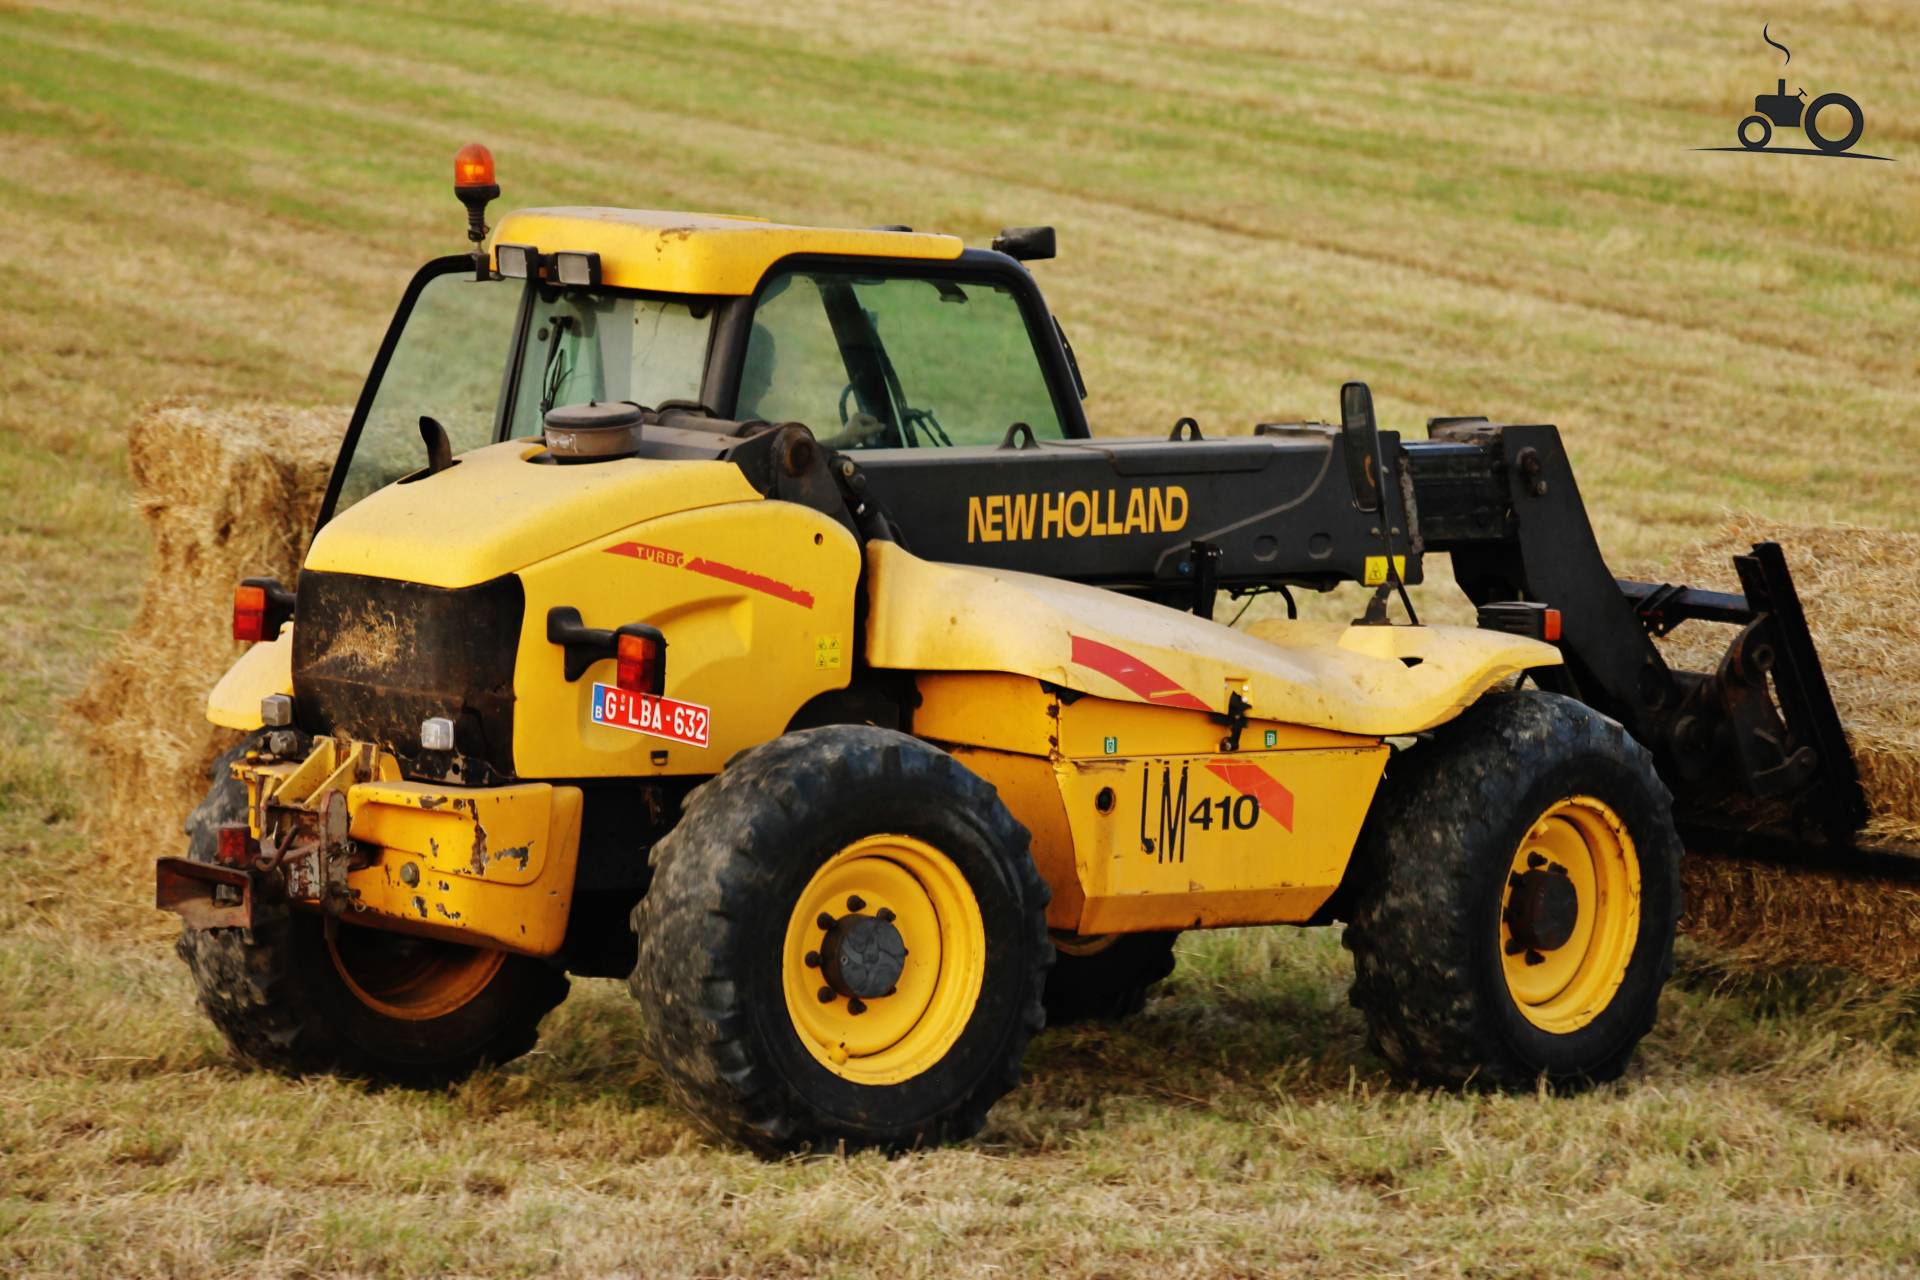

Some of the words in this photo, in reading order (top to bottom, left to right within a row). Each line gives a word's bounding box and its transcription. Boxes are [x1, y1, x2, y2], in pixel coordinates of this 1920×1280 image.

[967, 495, 1038, 543] NEW
[1041, 486, 1189, 539] HOLLAND
[595, 705, 603, 719] B
